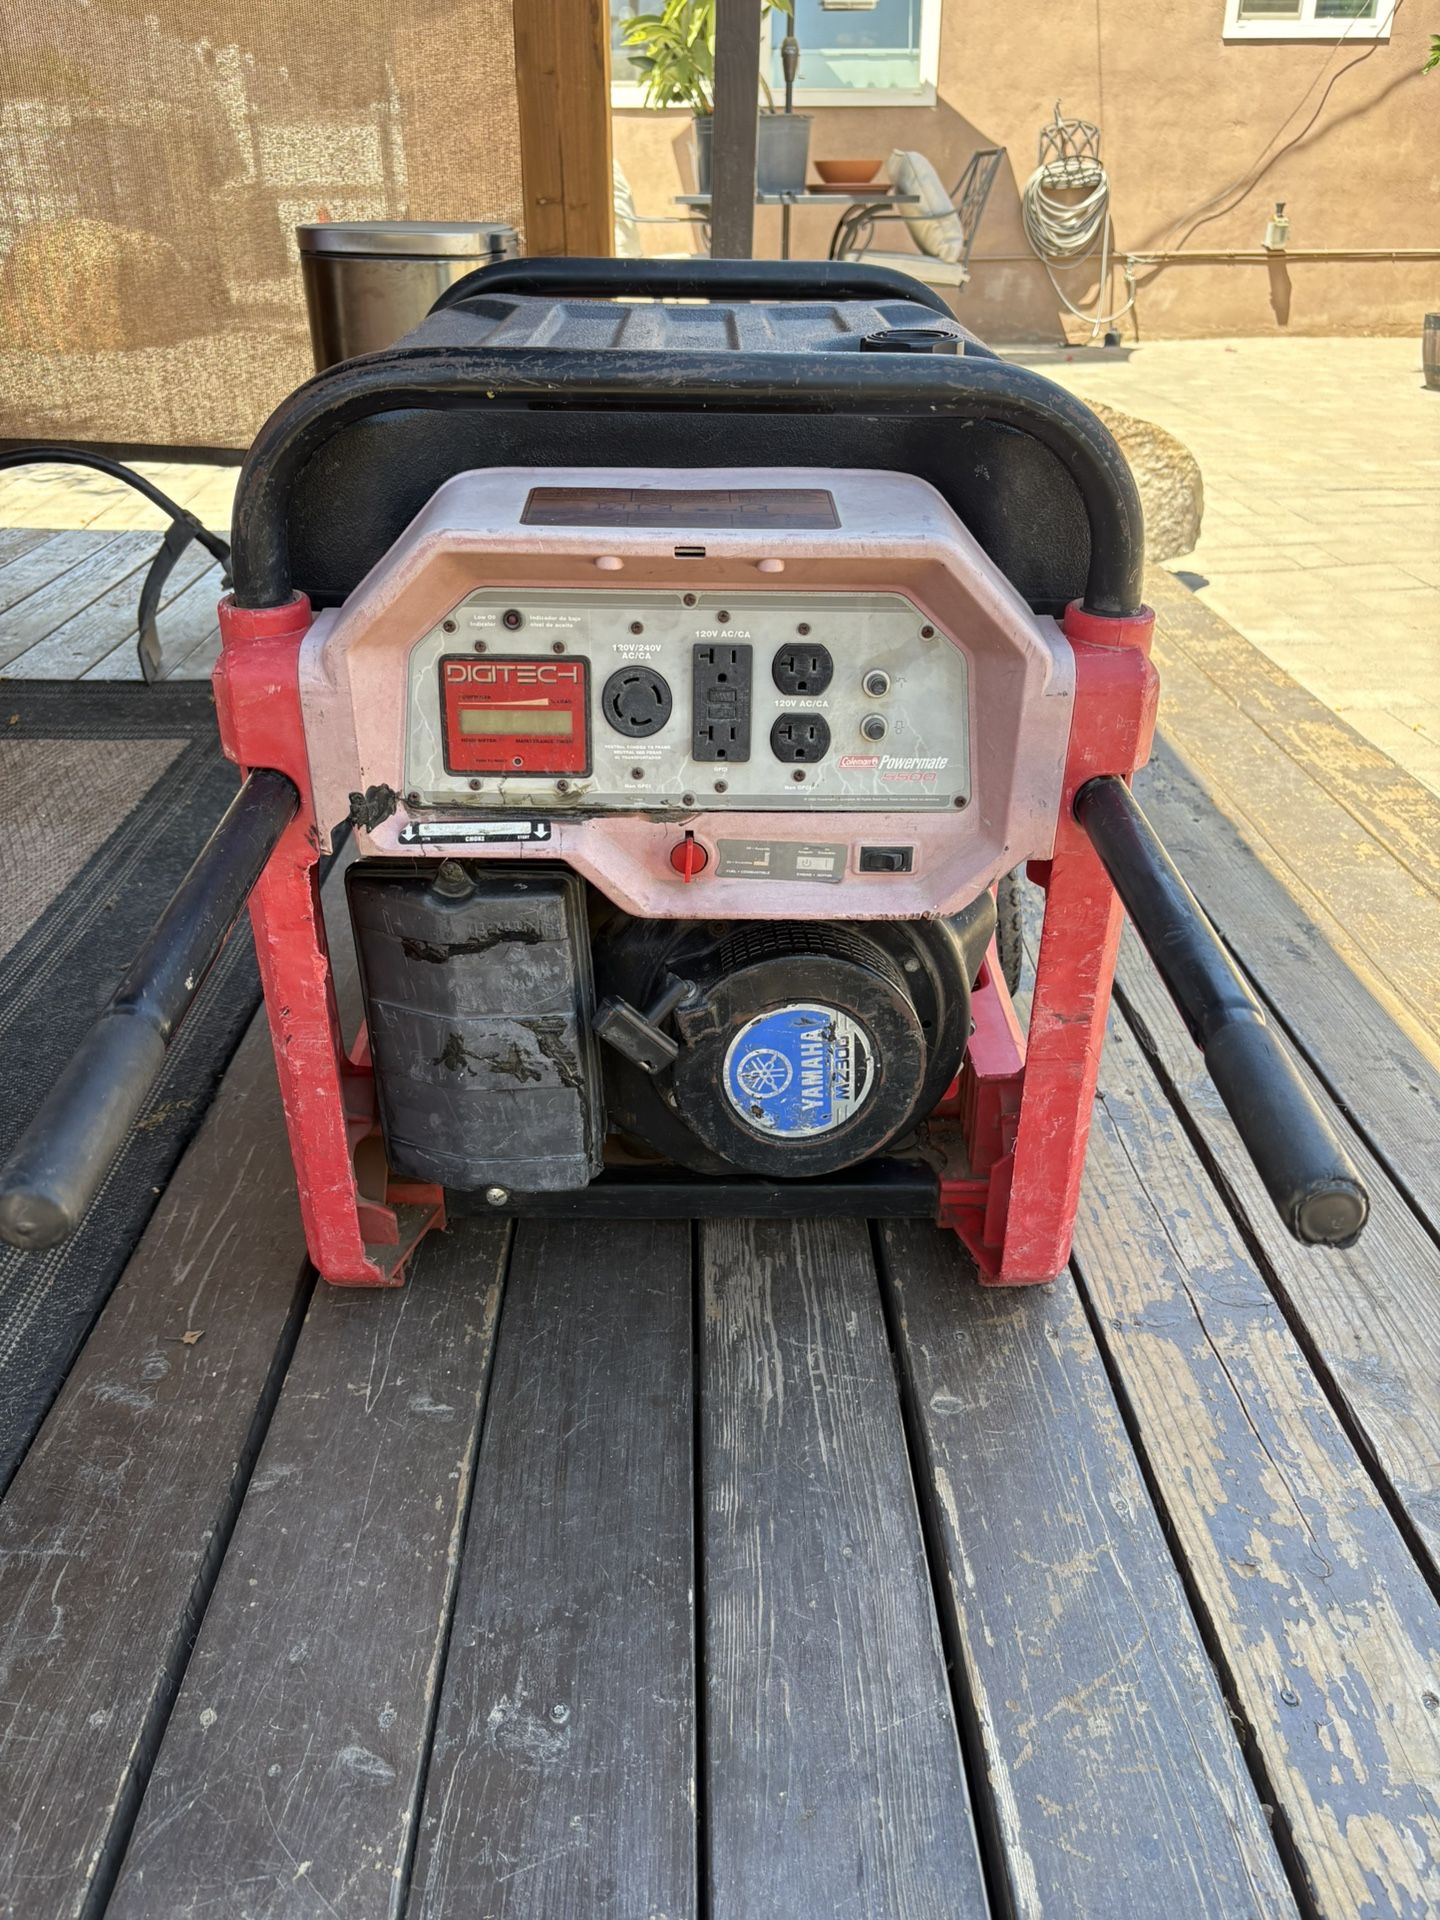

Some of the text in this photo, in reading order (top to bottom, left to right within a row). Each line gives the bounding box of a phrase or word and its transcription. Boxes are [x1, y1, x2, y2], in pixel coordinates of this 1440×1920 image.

[695, 630, 751, 638] 120V AC/CA
[612, 644, 662, 652] 120V/240V
[622, 652, 651, 660] AC/CA
[447, 664, 578, 684] DIGITECH
[774, 700, 829, 708] 120V AC/CA
[879, 754, 949, 770] Powermate
[800, 1028, 824, 1112] YAMAHA
